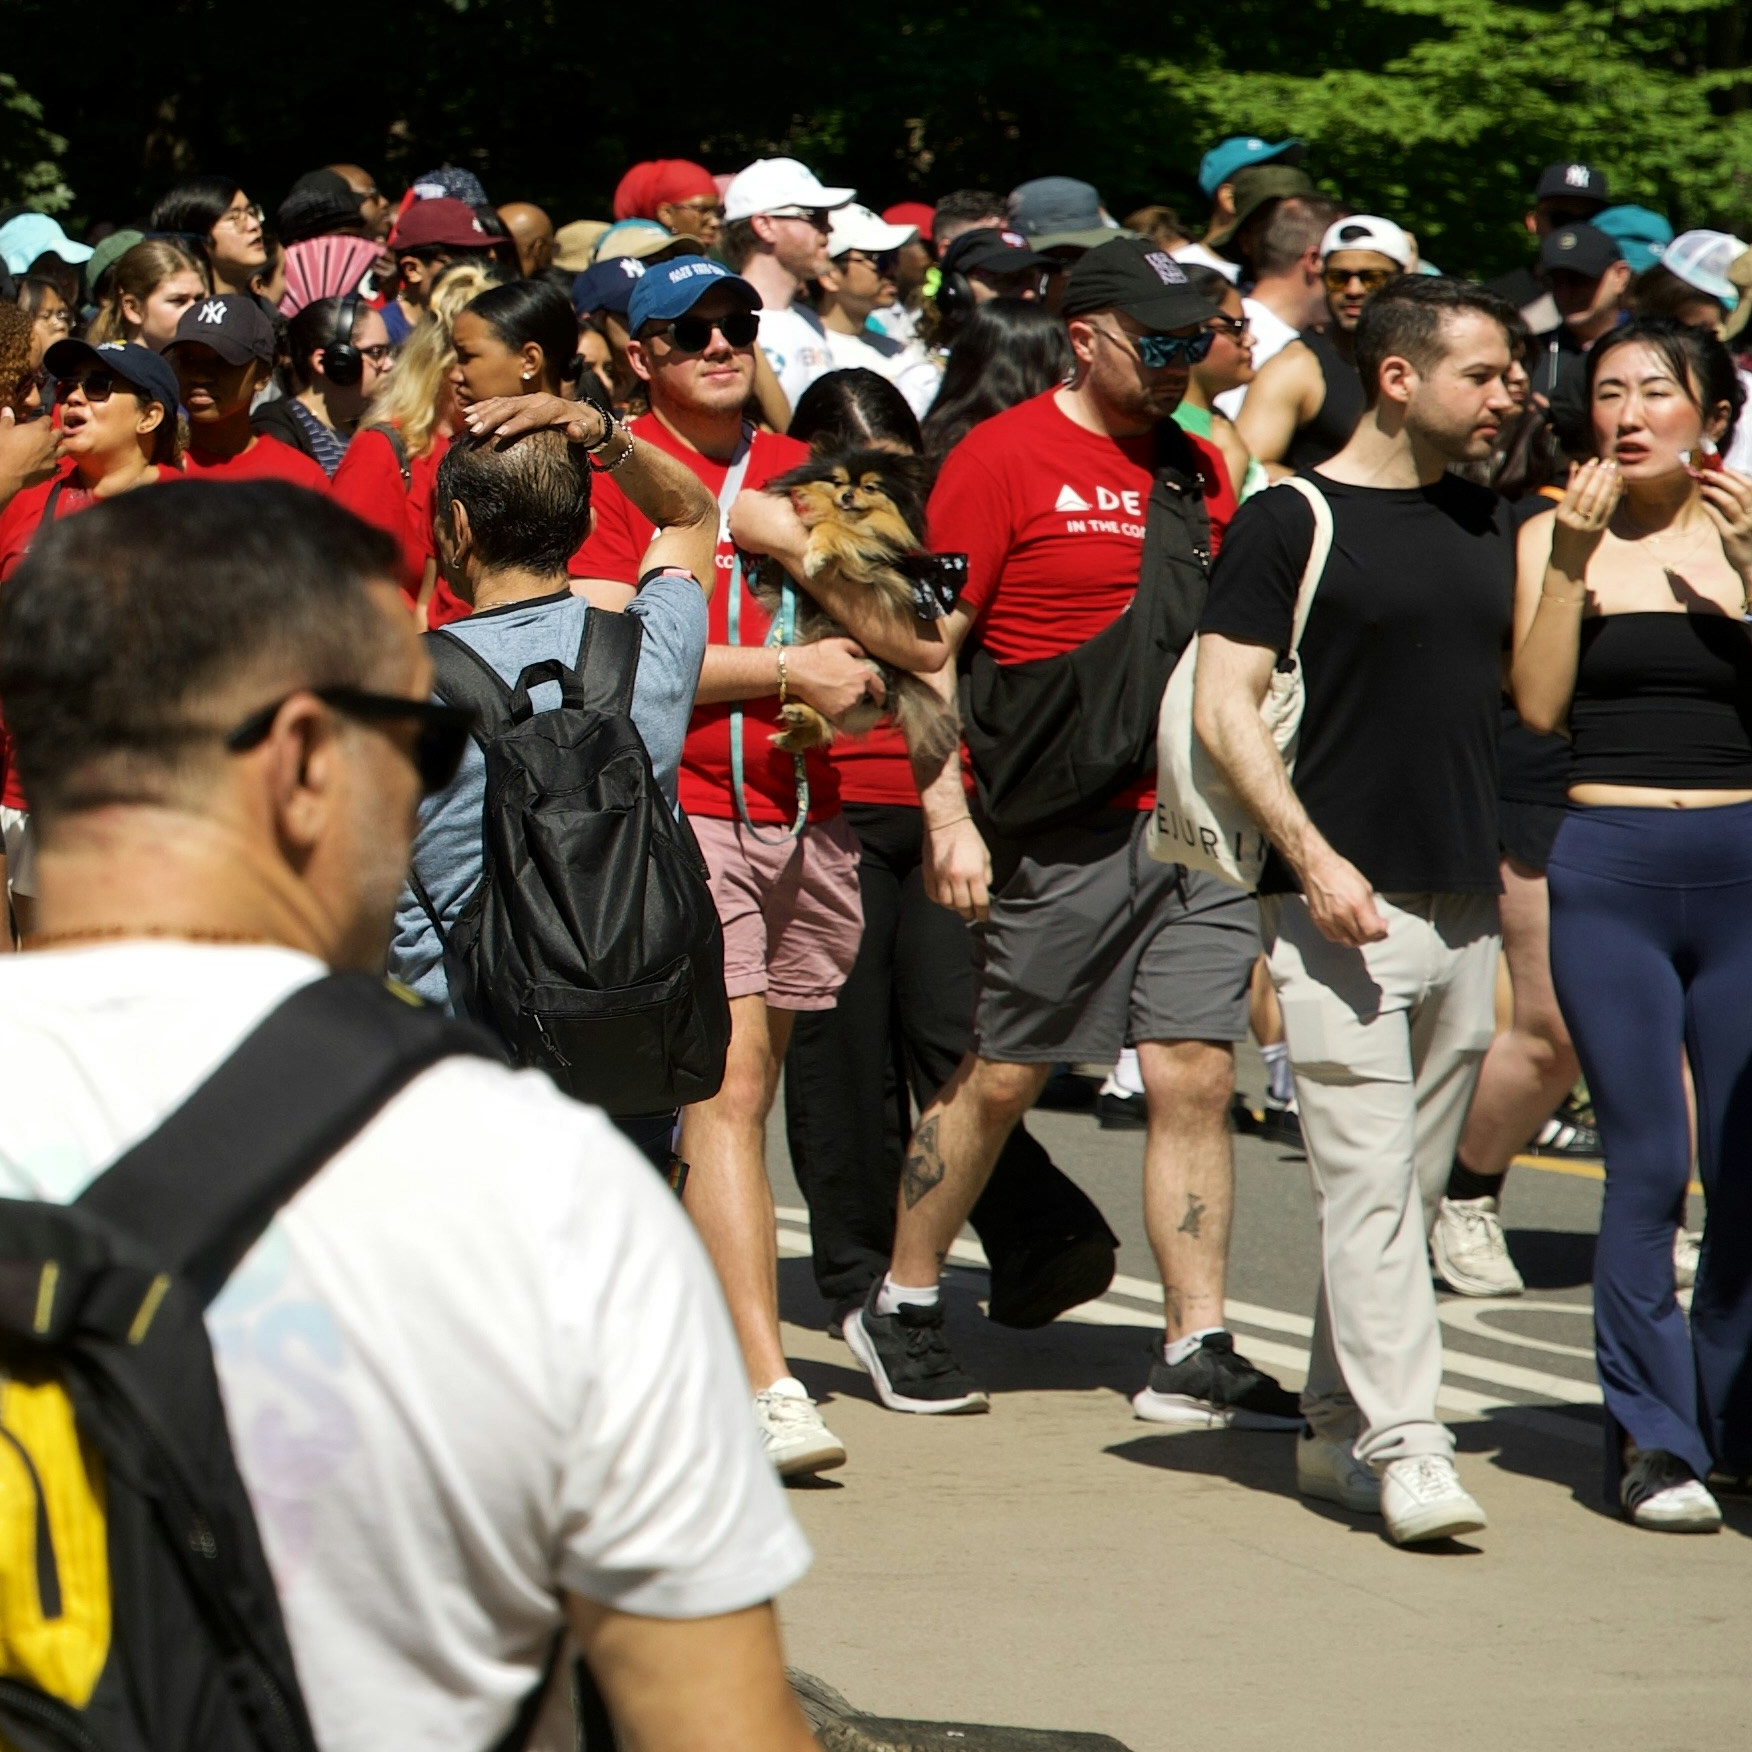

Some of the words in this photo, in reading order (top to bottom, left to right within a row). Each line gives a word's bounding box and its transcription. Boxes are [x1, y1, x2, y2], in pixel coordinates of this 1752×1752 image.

[197, 300, 228, 325] NY
[1066, 519, 1086, 533] IN
[1088, 519, 1120, 534] THE
